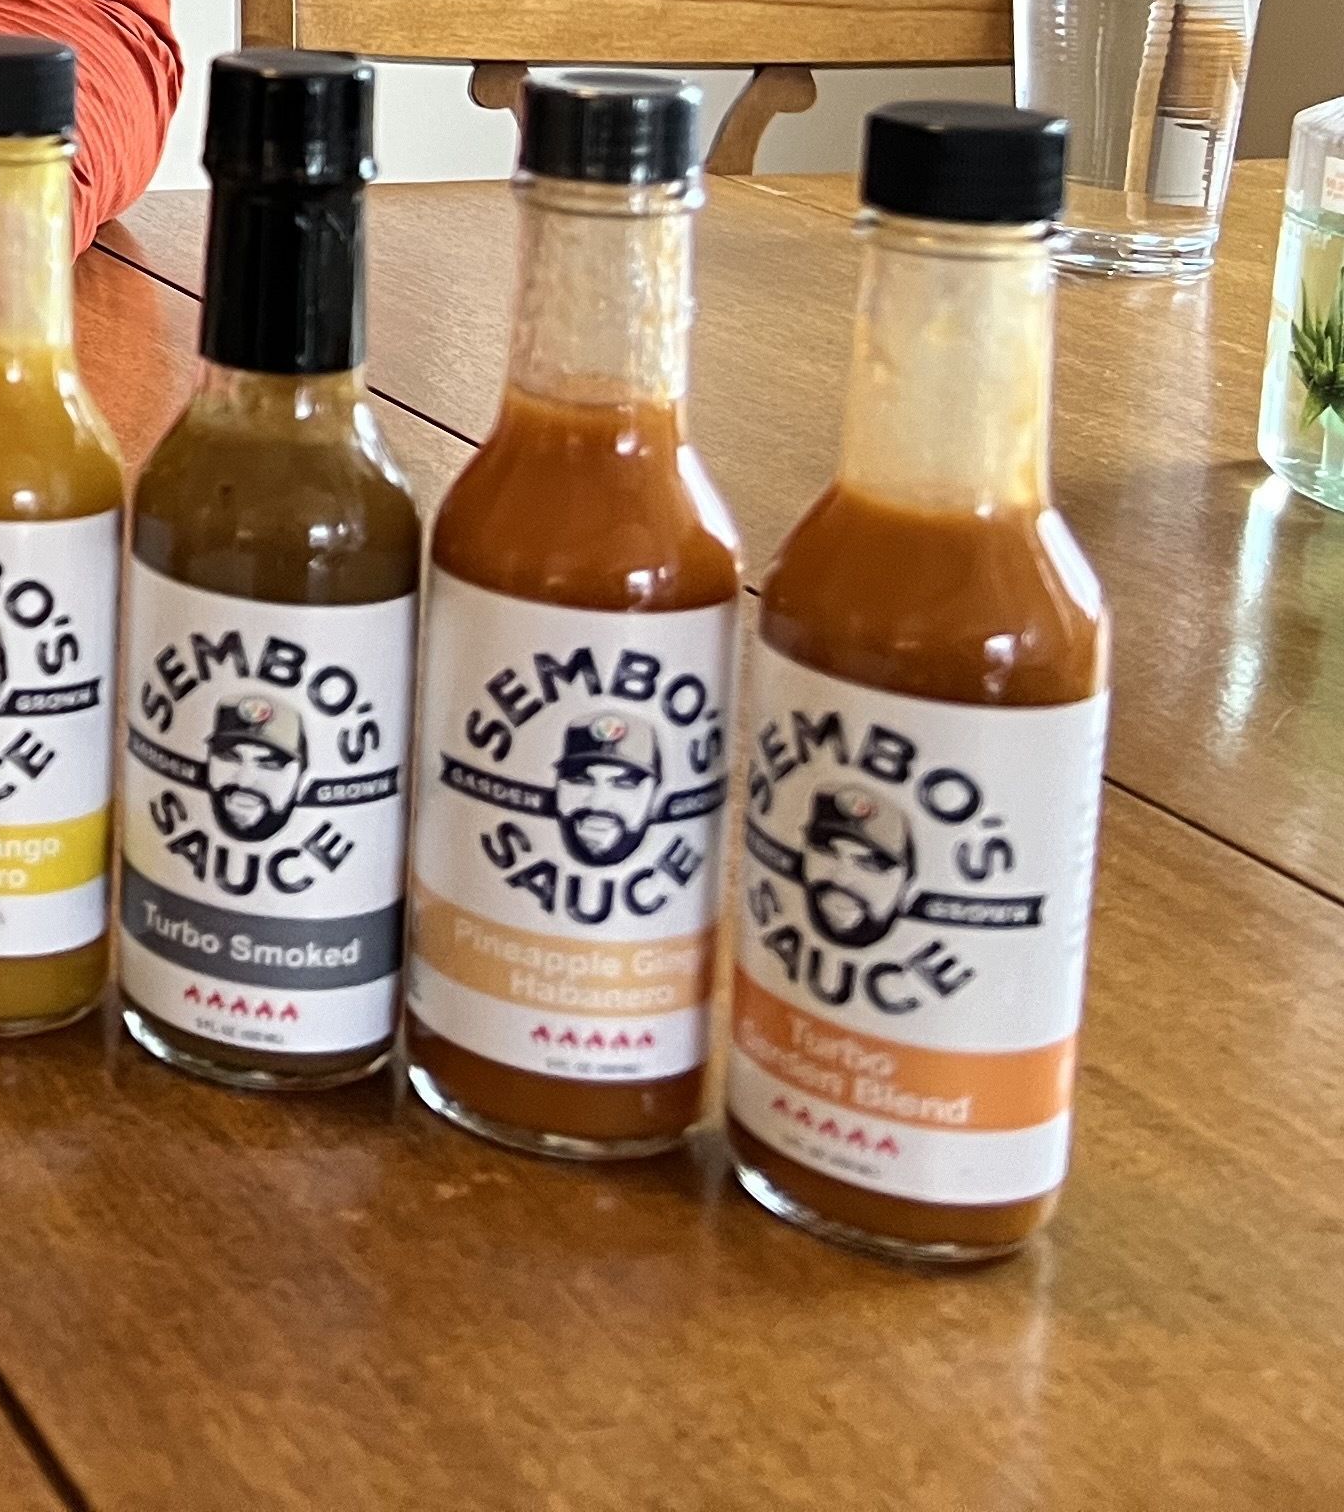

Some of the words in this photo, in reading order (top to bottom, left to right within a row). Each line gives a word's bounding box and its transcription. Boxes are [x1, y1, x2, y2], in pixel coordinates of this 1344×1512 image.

[140, 628, 381, 766] SEMBO'S
[465, 646, 724, 775] SEMBO'S
[149, 790, 356, 897] SAUCE
[316, 774, 393, 802] GROWN
[748, 710, 1015, 884] SEMBO'S
[480, 819, 706, 925] SAUCE
[142, 901, 220, 955] Turbo
[229, 934, 362, 969] Smoked
[748, 880, 977, 1017] SAUCE
